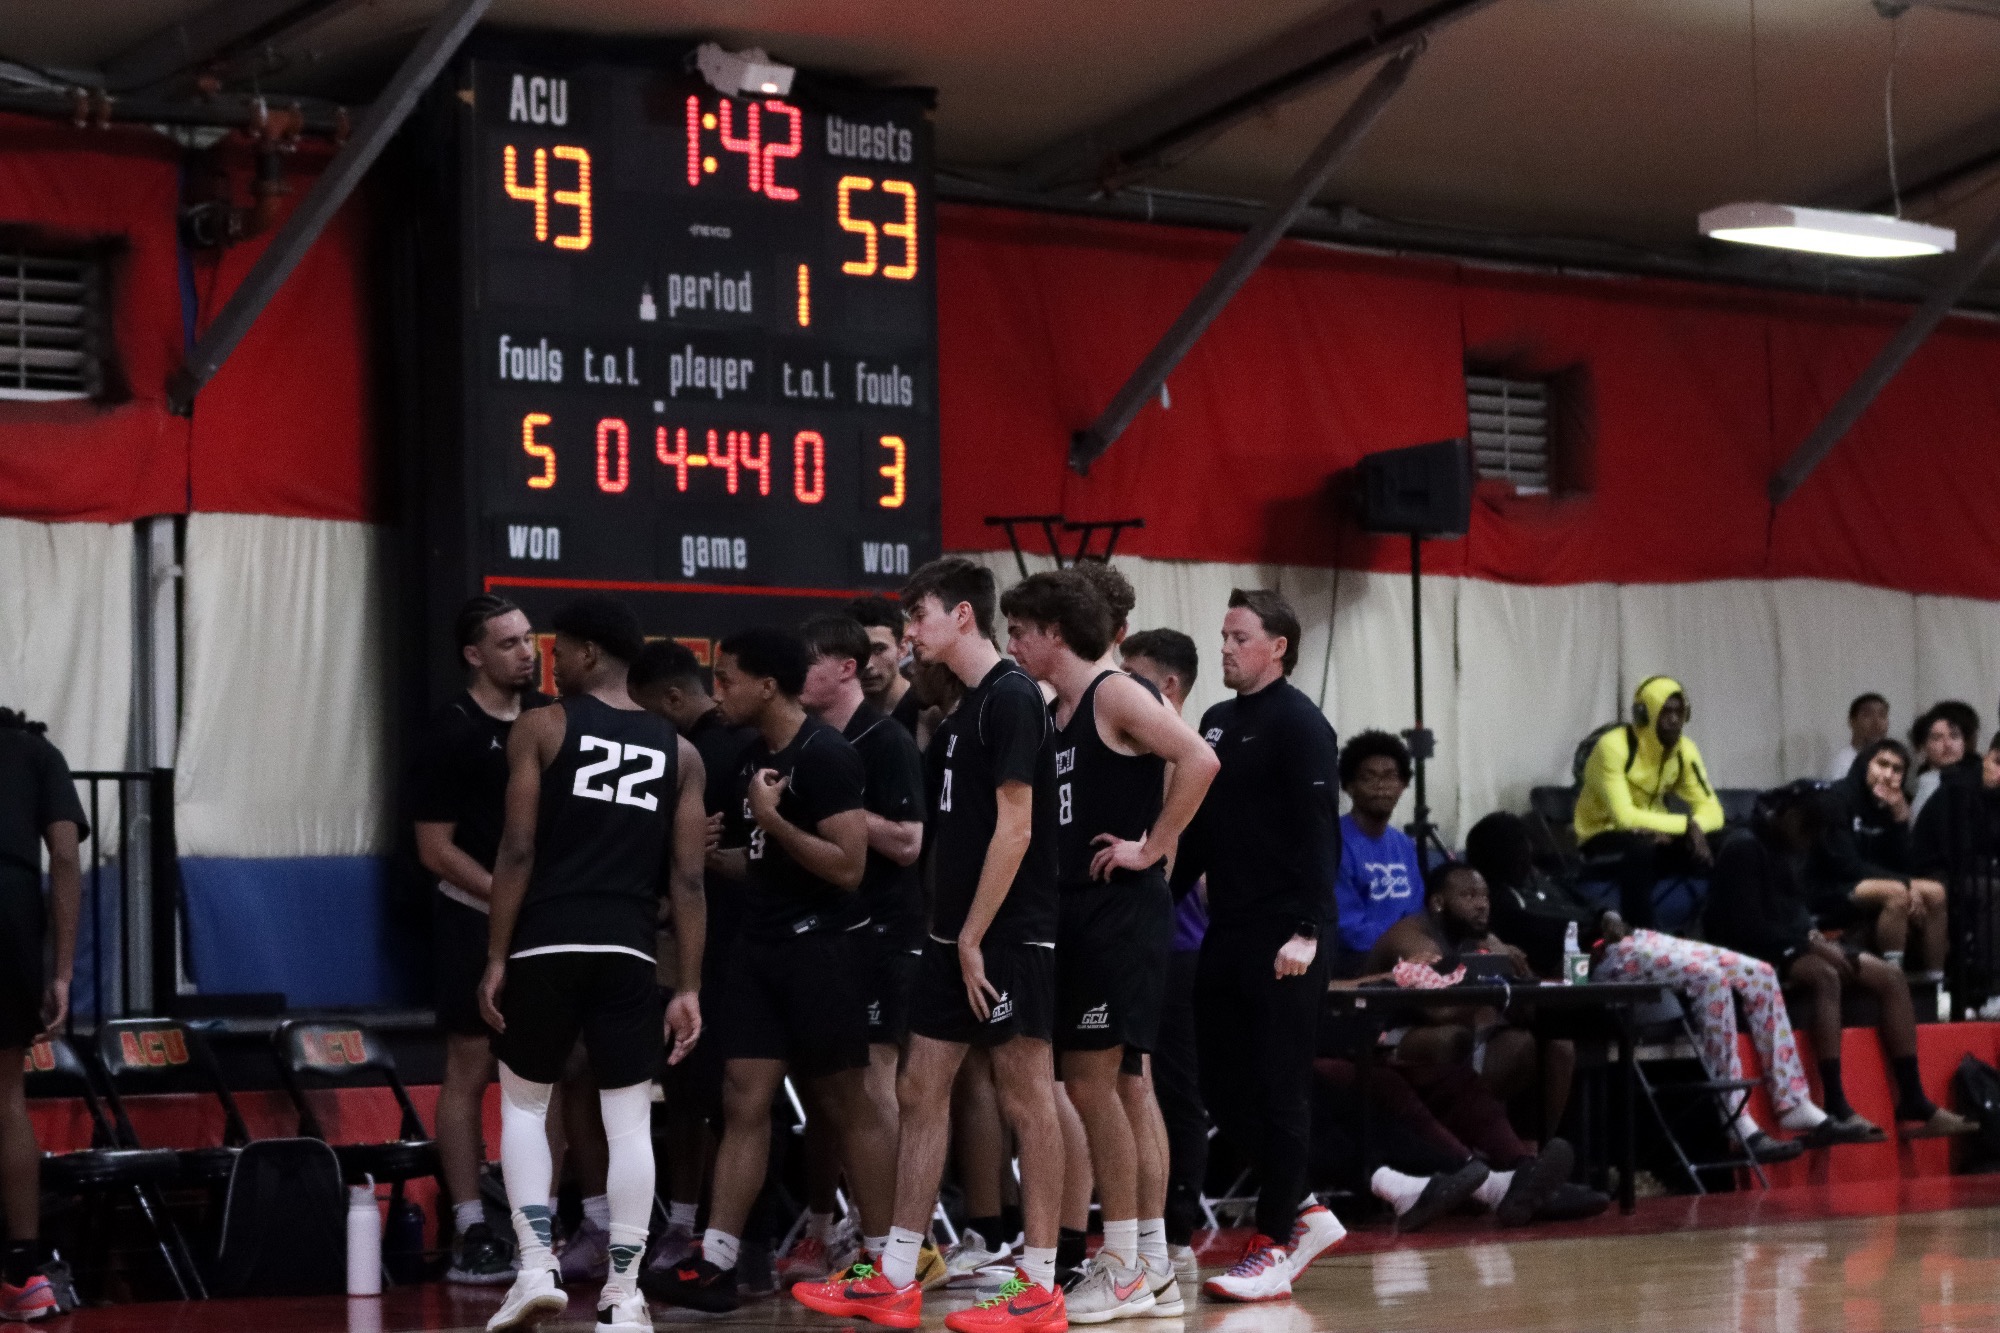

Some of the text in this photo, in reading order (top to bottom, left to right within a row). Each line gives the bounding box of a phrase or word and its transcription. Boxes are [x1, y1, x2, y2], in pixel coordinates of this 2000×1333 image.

[509, 74, 568, 126] ACU
[687, 94, 802, 202] 1:42
[826, 114, 912, 163] Guests
[503, 145, 592, 250] 43
[837, 175, 918, 280] 53
[667, 270, 753, 317] period
[797, 263, 810, 328] 1
[499, 334, 563, 383] fouls
[669, 345, 754, 398] player
[856, 362, 914, 406] fouls
[522, 413, 557, 489] 5
[596, 418, 629, 493] 0
[793, 431, 825, 504] 0
[878, 435, 906, 508] 3
[508, 524, 910, 578] won game won
[572, 735, 667, 812] 22
[1059, 782, 1073, 826] 8
[992, 1000, 1013, 1018] GCU
[1081, 1012, 1109, 1024] GCU
[120, 1029, 189, 1067] ACU
[302, 1030, 367, 1065] ACU
